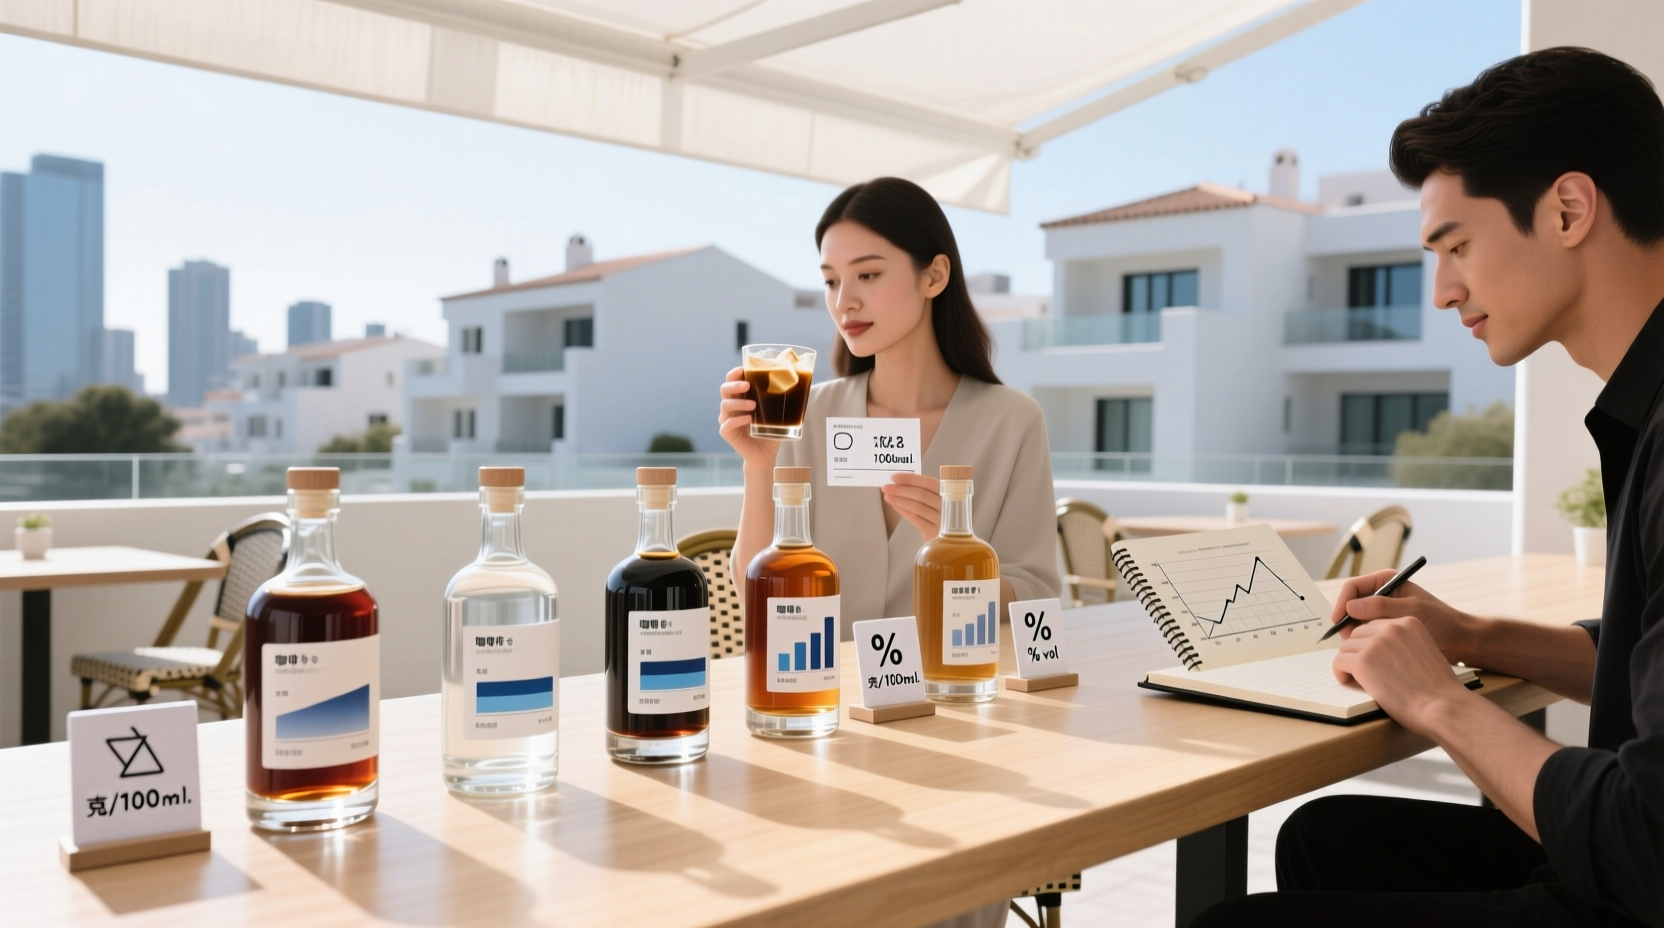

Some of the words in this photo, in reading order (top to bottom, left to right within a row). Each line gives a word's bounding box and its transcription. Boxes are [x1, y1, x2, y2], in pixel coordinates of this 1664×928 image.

[1024, 610, 1052, 642] %
[871, 632, 903, 668] %
[1027, 646, 1040, 663] %
[1042, 644, 1059, 660] vol
